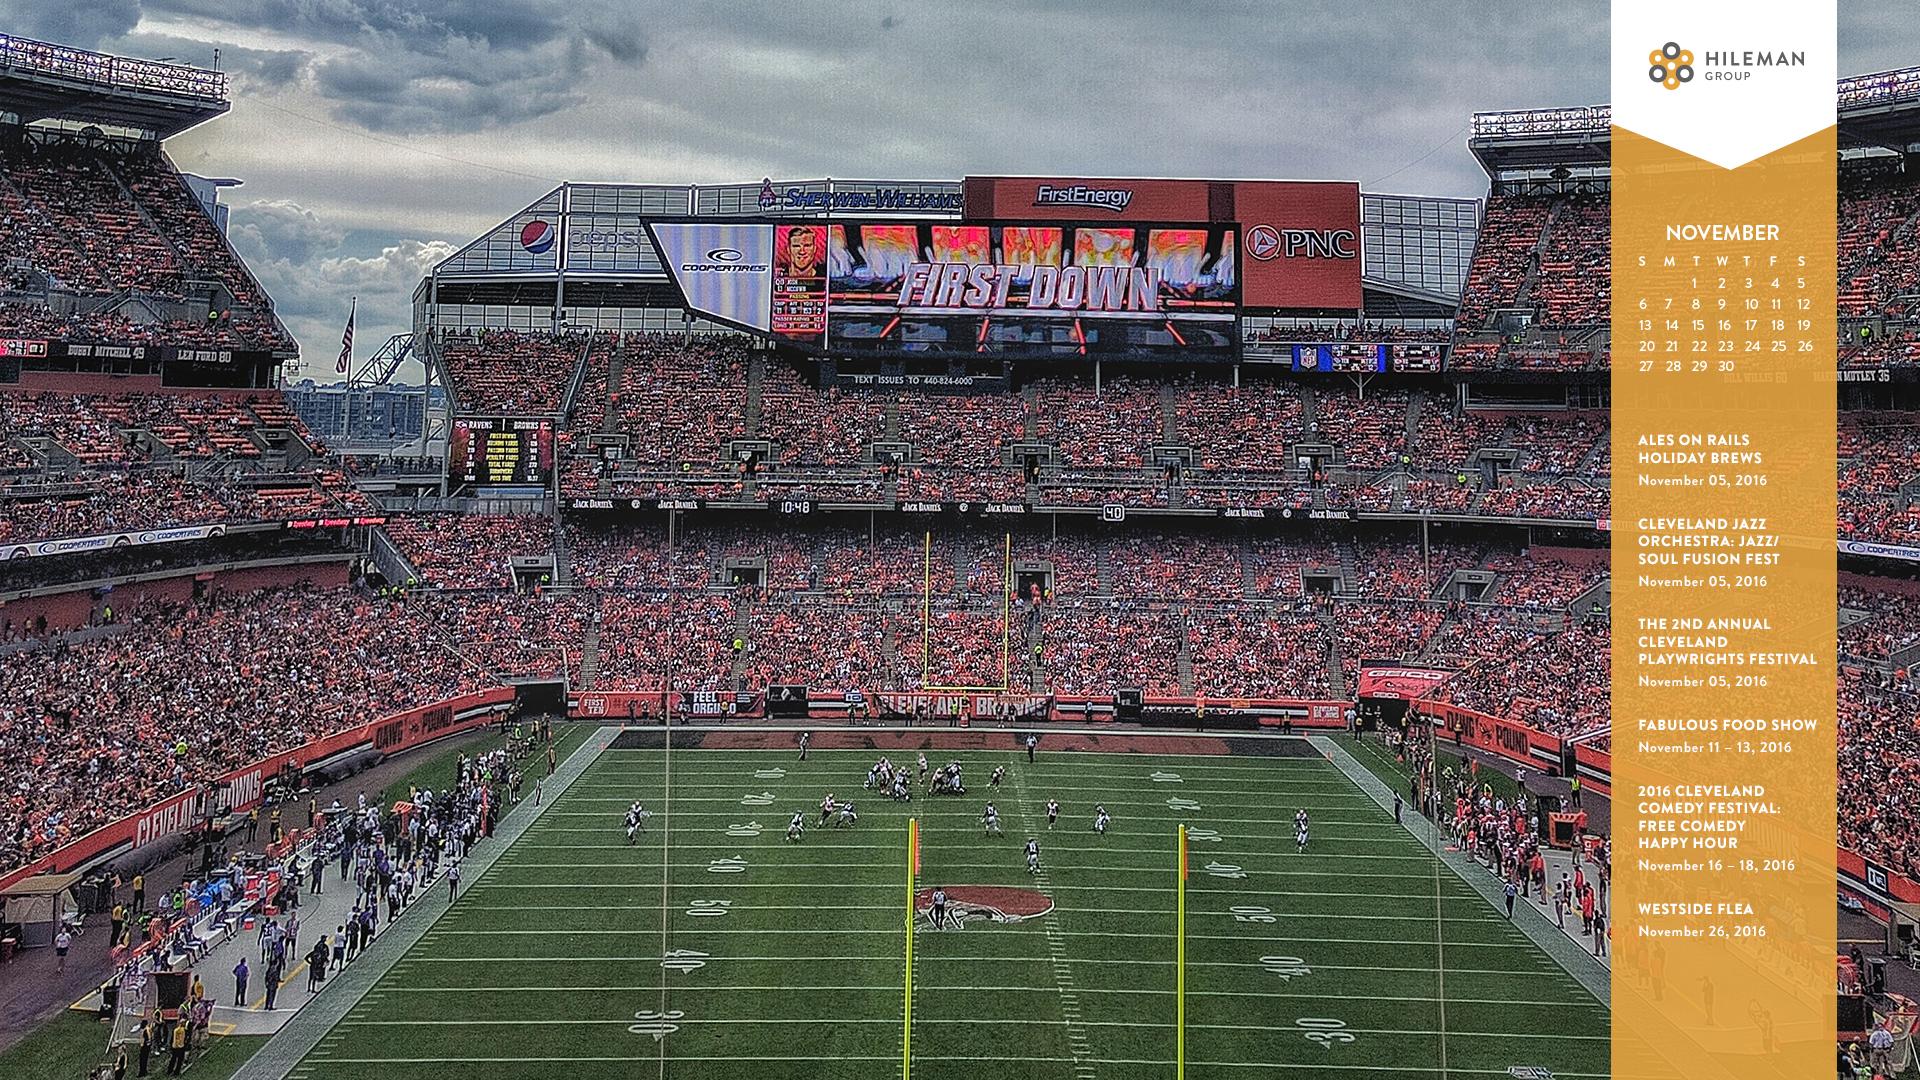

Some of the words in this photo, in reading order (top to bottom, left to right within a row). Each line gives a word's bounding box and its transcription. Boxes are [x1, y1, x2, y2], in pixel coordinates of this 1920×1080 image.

[786, 188, 963, 208] SHERWIN-WILLIAMS
[1036, 185, 1133, 206] FirstEnergy
[569, 229, 642, 252] pepsi
[1282, 229, 1356, 258] PNC
[681, 263, 768, 273] COOPERTIRES
[897, 262, 1020, 308] FIRST
[1026, 264, 1160, 311] DOWN
[95, 345, 131, 358] MITCHELL
[133, 346, 145, 359] 49
[177, 350, 194, 361] LEN
[218, 351, 232, 363] 80
[854, 375, 873, 384] TEXT
[878, 375, 904, 385] ISSUES
[908, 376, 920, 385] TO
[923, 376, 974, 386] 440-824-6000
[468, 420, 493, 430] RAVENS
[513, 421, 539, 430] BROWNS
[781, 501, 810, 514] 10:48
[902, 502, 918, 512] JACK
[985, 503, 1001, 513] JACK
[1224, 508, 1240, 517] JACK
[1106, 507, 1121, 519] 40
[1309, 509, 1325, 519] JACK
[1368, 670, 1443, 680] GEICO
[584, 698, 605, 707] FIRST
[693, 691, 717, 703] FEEL
[588, 706, 604, 715] TEN
[692, 703, 737, 714] ORGUO
